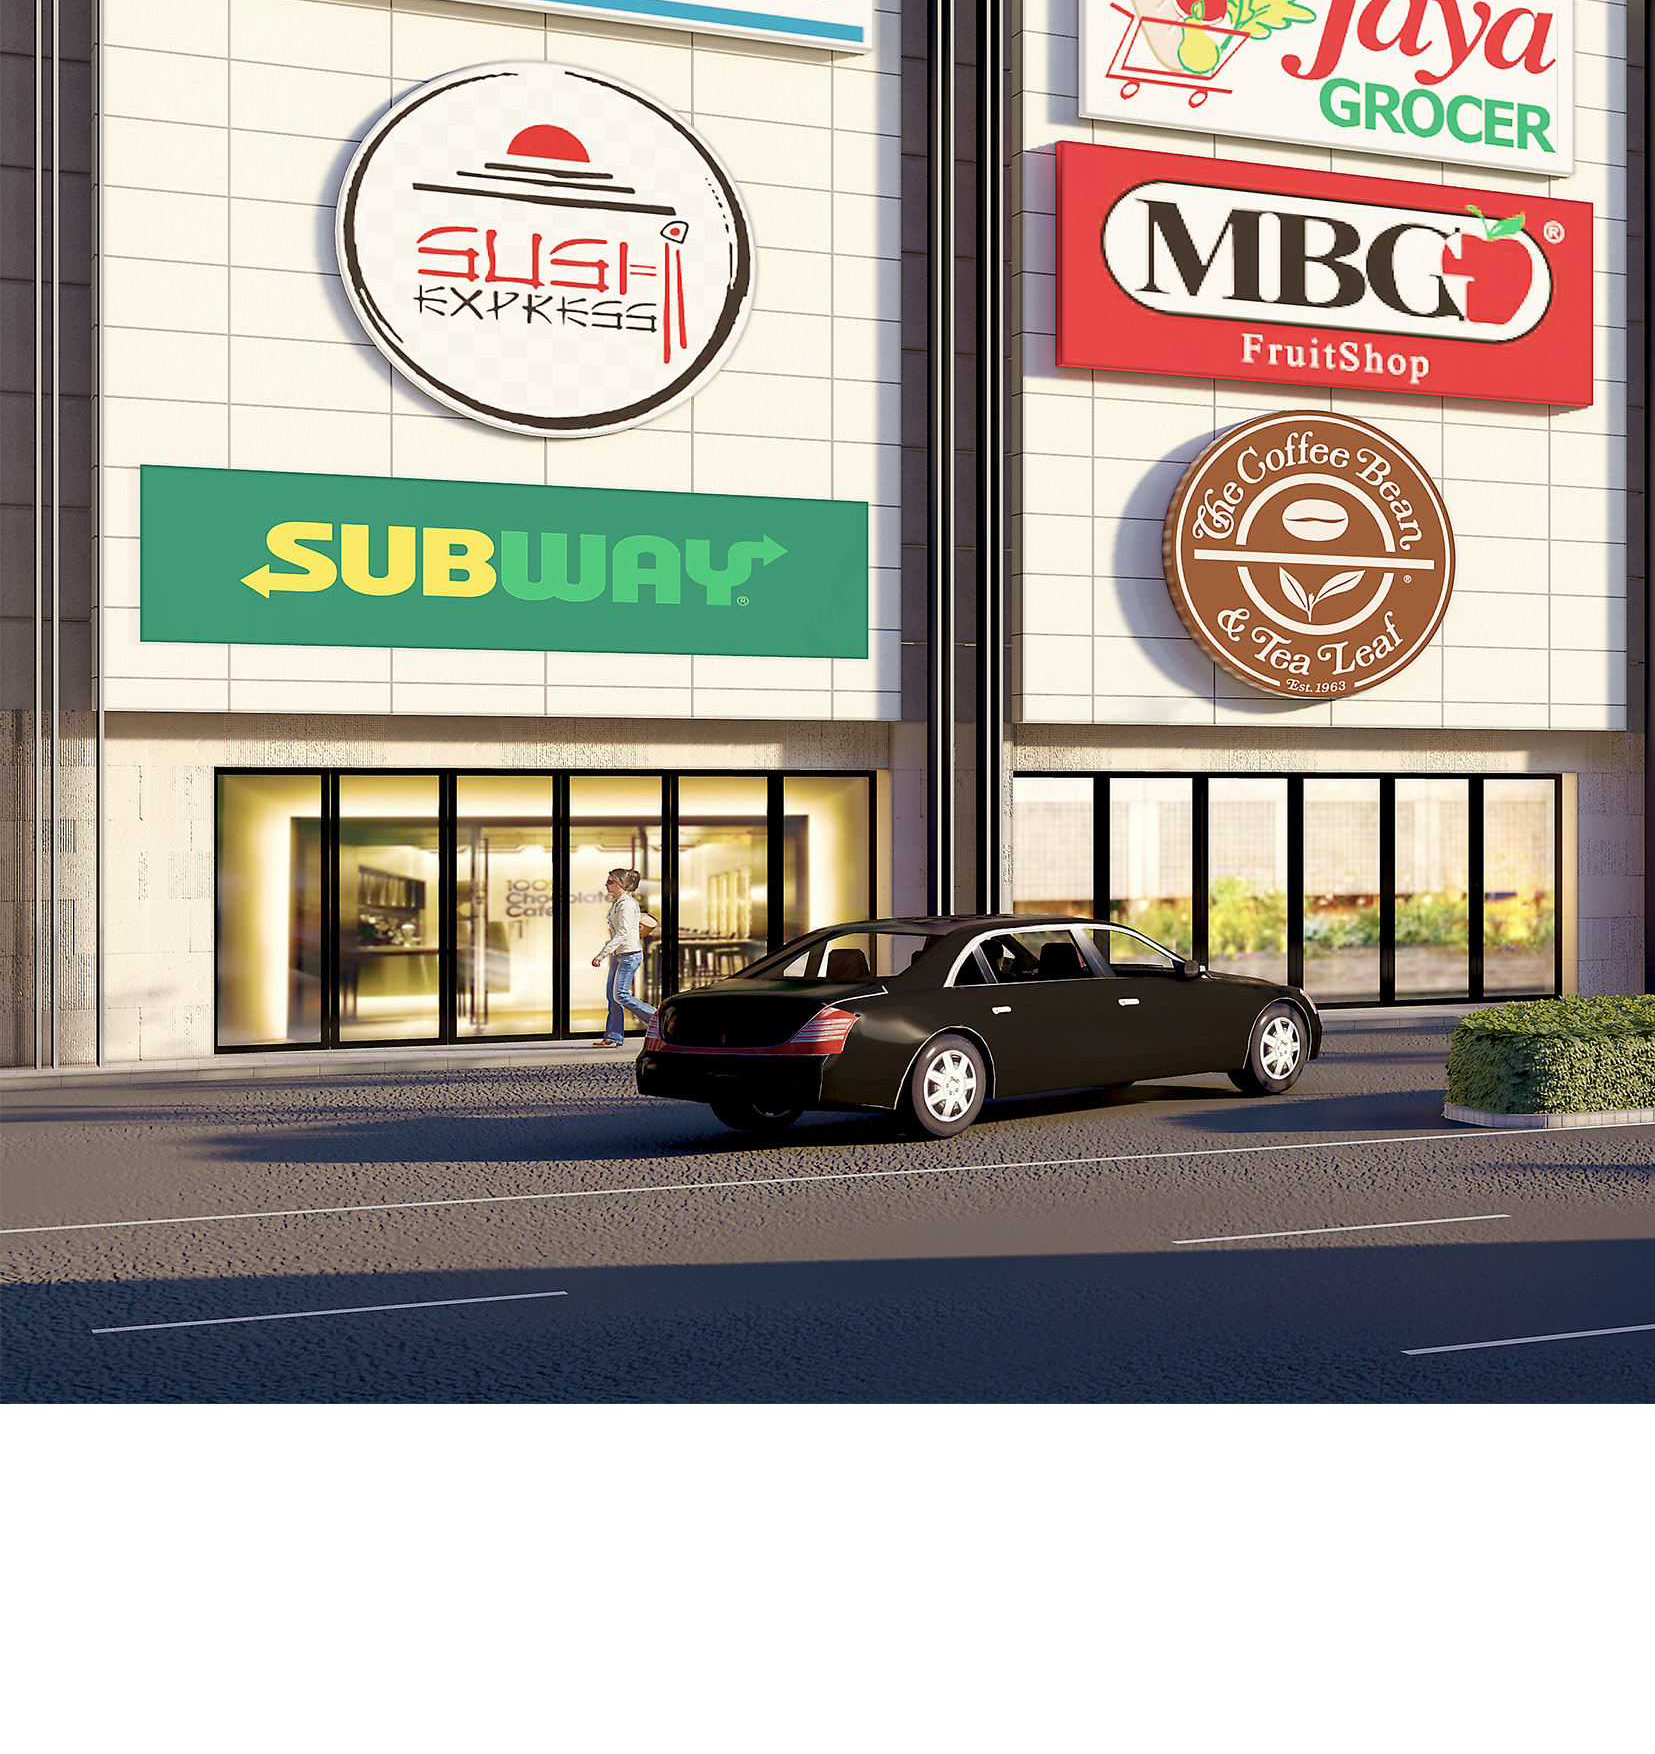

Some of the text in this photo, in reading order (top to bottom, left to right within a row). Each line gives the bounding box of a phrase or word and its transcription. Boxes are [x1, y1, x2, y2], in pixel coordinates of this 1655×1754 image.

[1319, 78, 1556, 153] GROCER
[416, 222, 689, 364] SUSHI
[1136, 198, 1466, 323] MBG
[413, 285, 657, 332] EXPRESS
[1241, 332, 1431, 385] FruitShop
[1193, 431, 1423, 551] The Coffee Bean
[241, 521, 788, 606] SUBWAY
[1217, 608, 1403, 676] & Tea Leaf
[1286, 678, 1346, 693] Est. 1963
[506, 879, 553, 892] 100
[506, 892, 616, 905] Choolate
